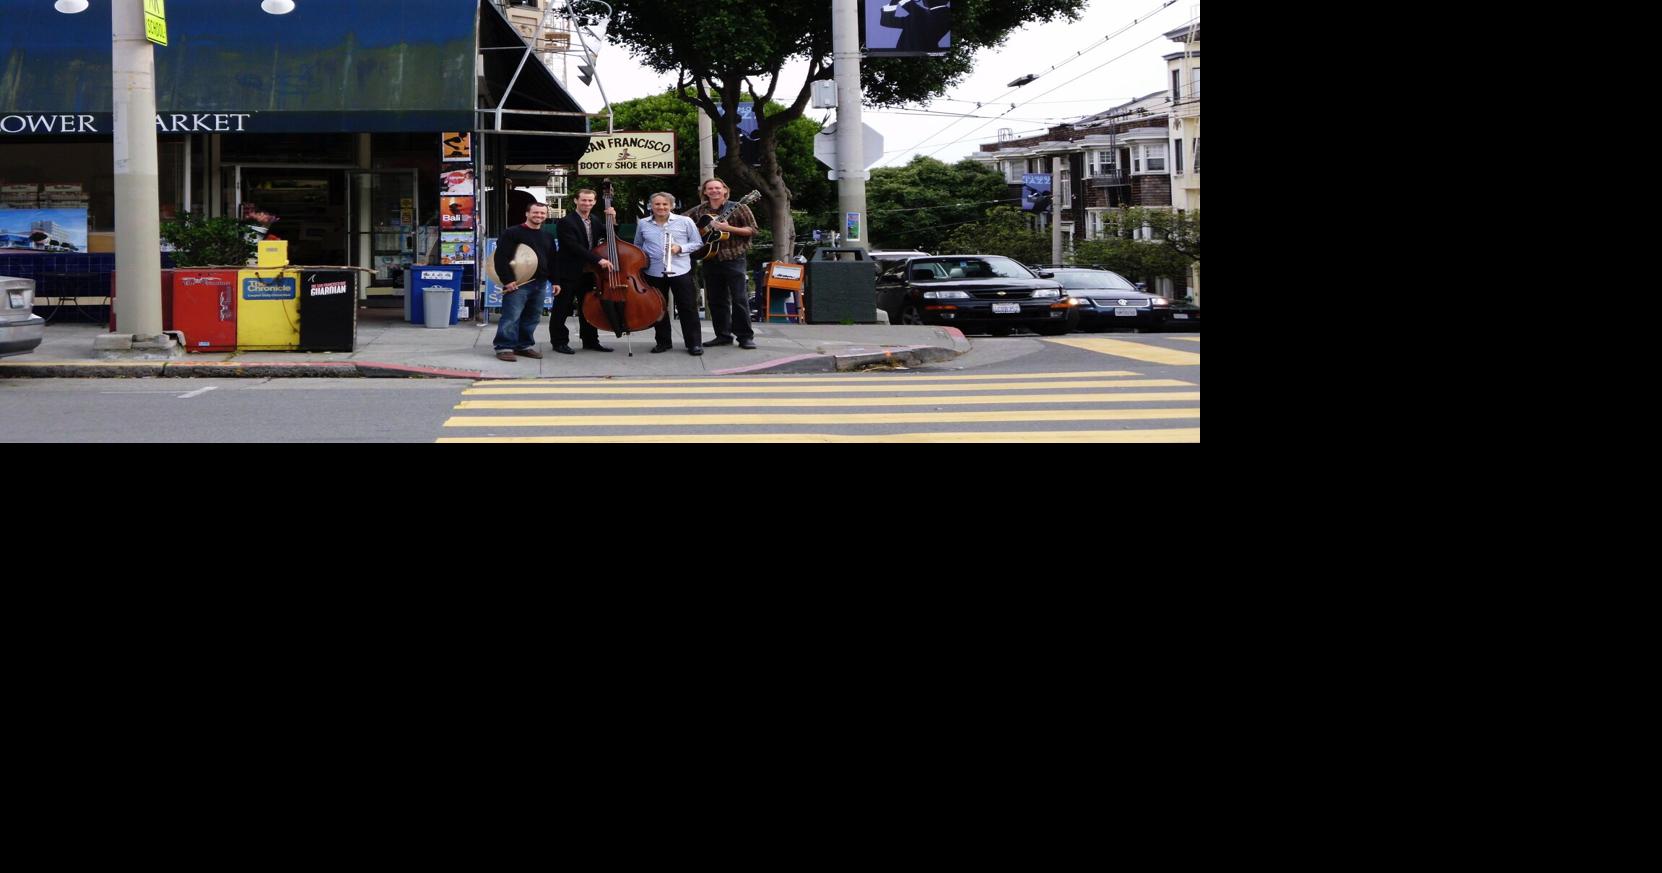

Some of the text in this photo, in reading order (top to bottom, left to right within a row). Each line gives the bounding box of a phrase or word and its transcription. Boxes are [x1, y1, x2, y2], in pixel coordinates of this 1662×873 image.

[0, 114, 250, 132] OWER ARKET
[608, 138, 671, 153] FRANCISCO
[580, 162, 605, 170] BOOT
[615, 161, 637, 169] SHOE
[641, 161, 674, 169] REPAIR
[442, 214, 461, 222] Bali
[247, 284, 292, 292] Chronicle
[310, 284, 347, 297] GUARDIAN
